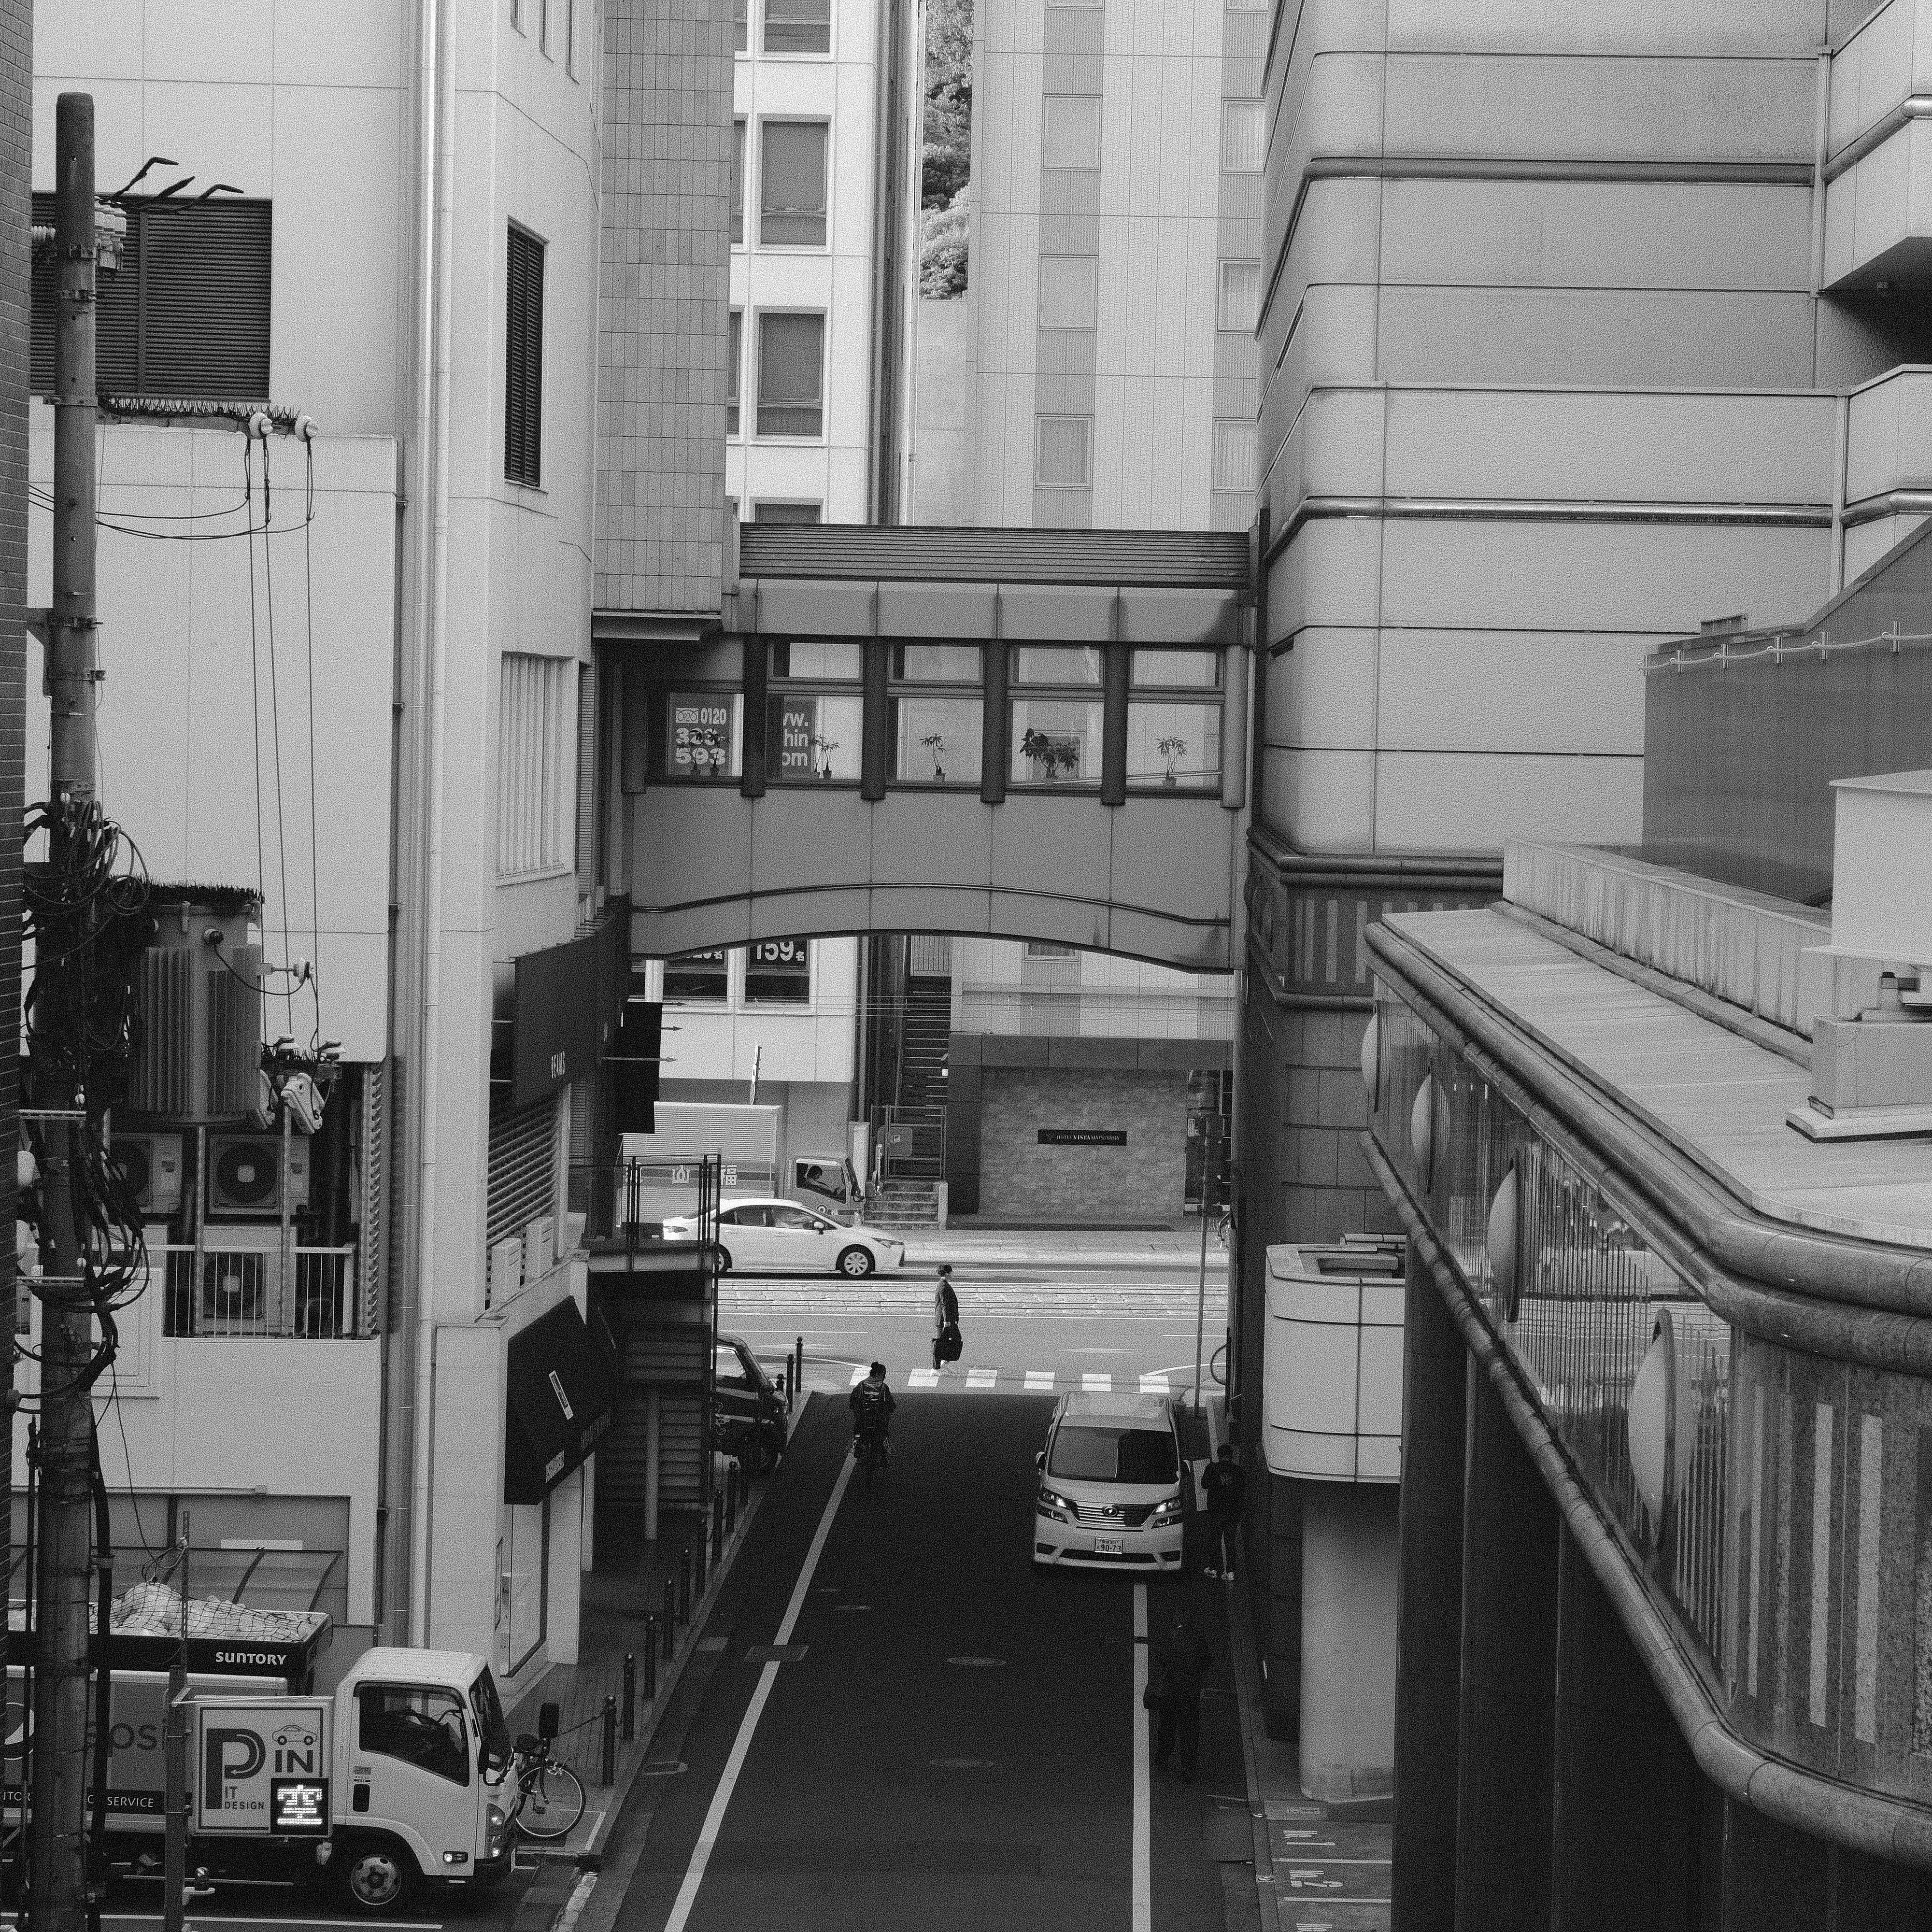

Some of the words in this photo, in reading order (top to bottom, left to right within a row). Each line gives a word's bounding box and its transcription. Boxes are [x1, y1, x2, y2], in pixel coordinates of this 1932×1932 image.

[700, 708, 727, 725] 0120
[784, 729, 809, 747] hin
[675, 748, 726, 765] 593
[215, 1651, 287, 1665] SUNTORY
[206, 1728, 266, 1809] P
[275, 1749, 313, 1773] IN
[225, 1786, 238, 1799] IT
[107, 1796, 154, 1808] SERVICE
[224, 1801, 265, 1810] DESIGN
[277, 1784, 323, 1825] 空
